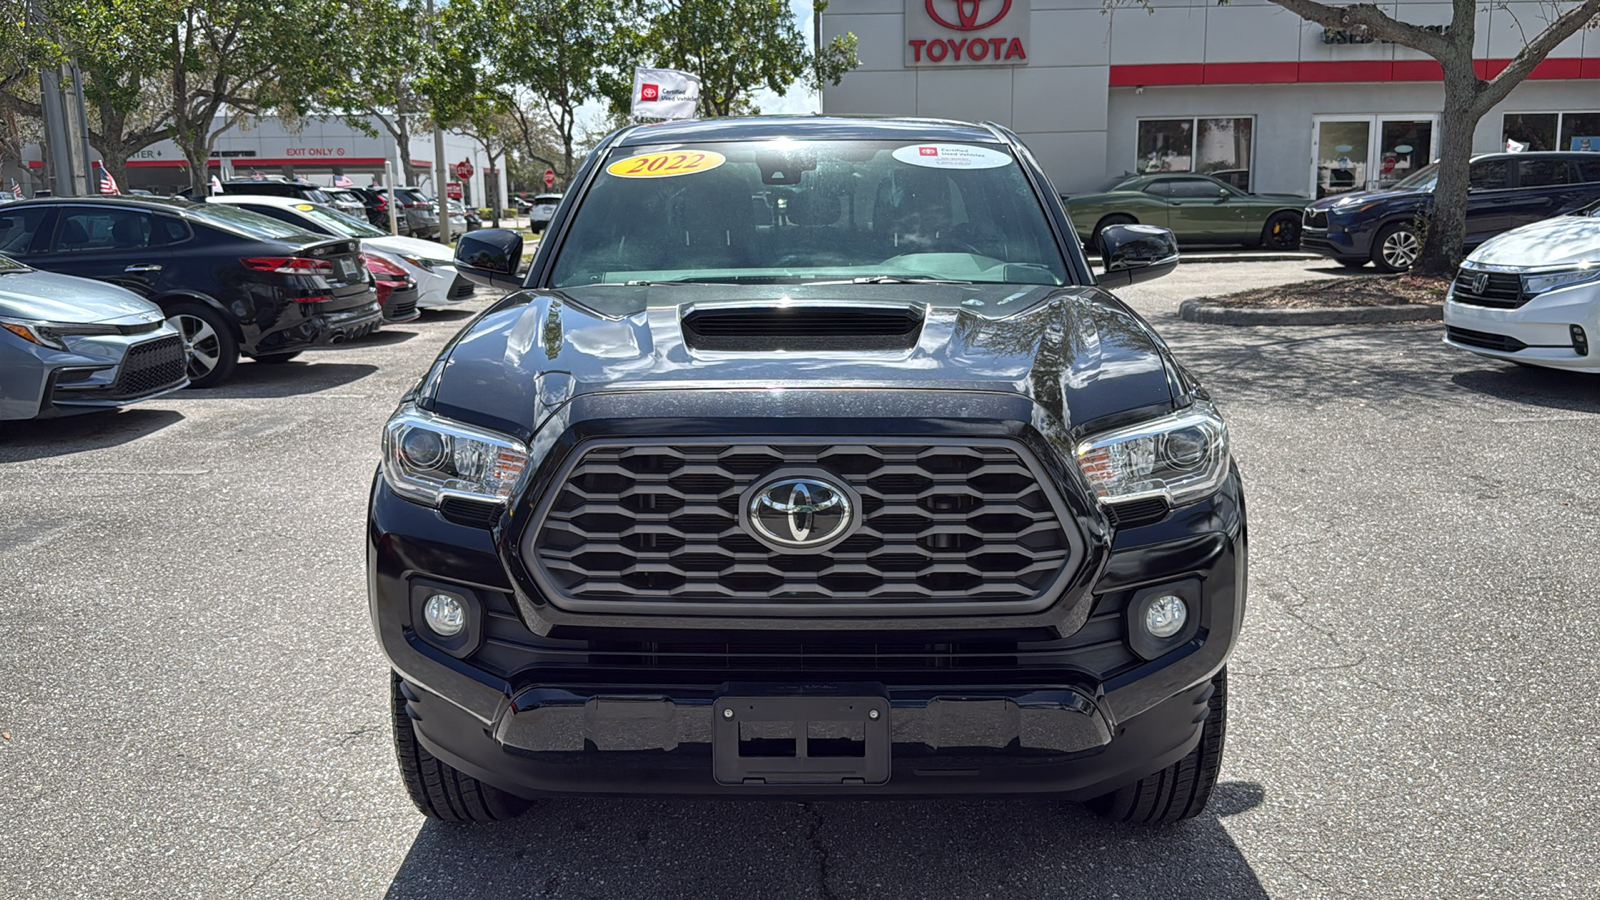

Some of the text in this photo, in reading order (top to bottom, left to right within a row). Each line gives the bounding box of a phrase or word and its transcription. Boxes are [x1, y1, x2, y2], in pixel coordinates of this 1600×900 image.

[1323, 26, 1374, 44] US
[908, 38, 1027, 62] TOYOTA
[286, 147, 333, 157] EXIT ONLY
[626, 154, 706, 174] 2022
